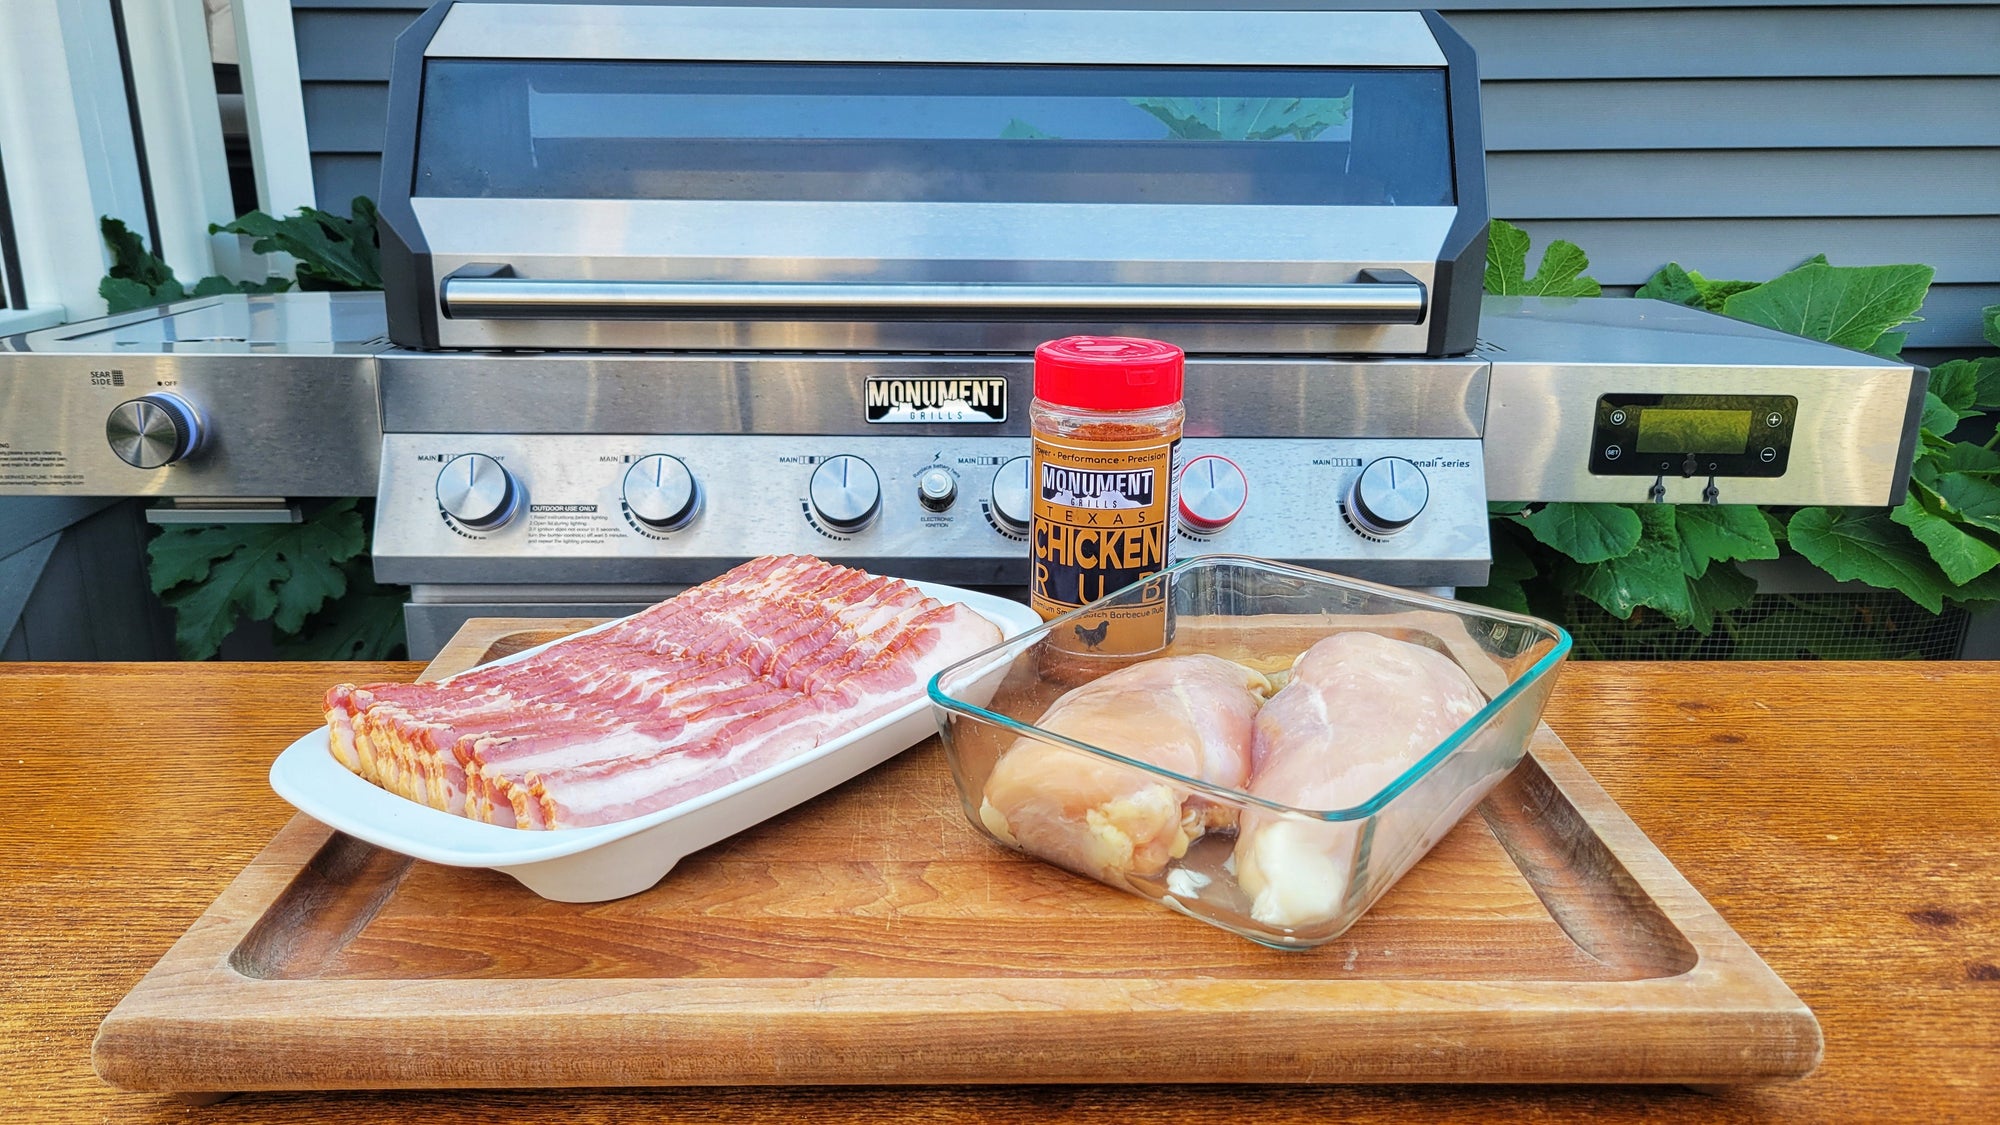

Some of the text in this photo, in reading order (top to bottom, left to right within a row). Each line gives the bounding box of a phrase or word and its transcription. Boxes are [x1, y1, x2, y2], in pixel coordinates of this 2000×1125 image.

[868, 381, 1003, 407] MONUMENT
[910, 411, 963, 420] GRILLS
[1057, 451, 1119, 464] Performance
[1127, 452, 1166, 464] Precision
[1441, 459, 1470, 468] series
[1043, 466, 1153, 497] MONUMENT
[1070, 498, 1118, 509] GRILLS
[1046, 506, 1146, 525] TEXAS
[1035, 520, 1161, 570] CHICKEN
[1035, 562, 1161, 604] RUB
[1110, 611, 1150, 619] Barbecue
